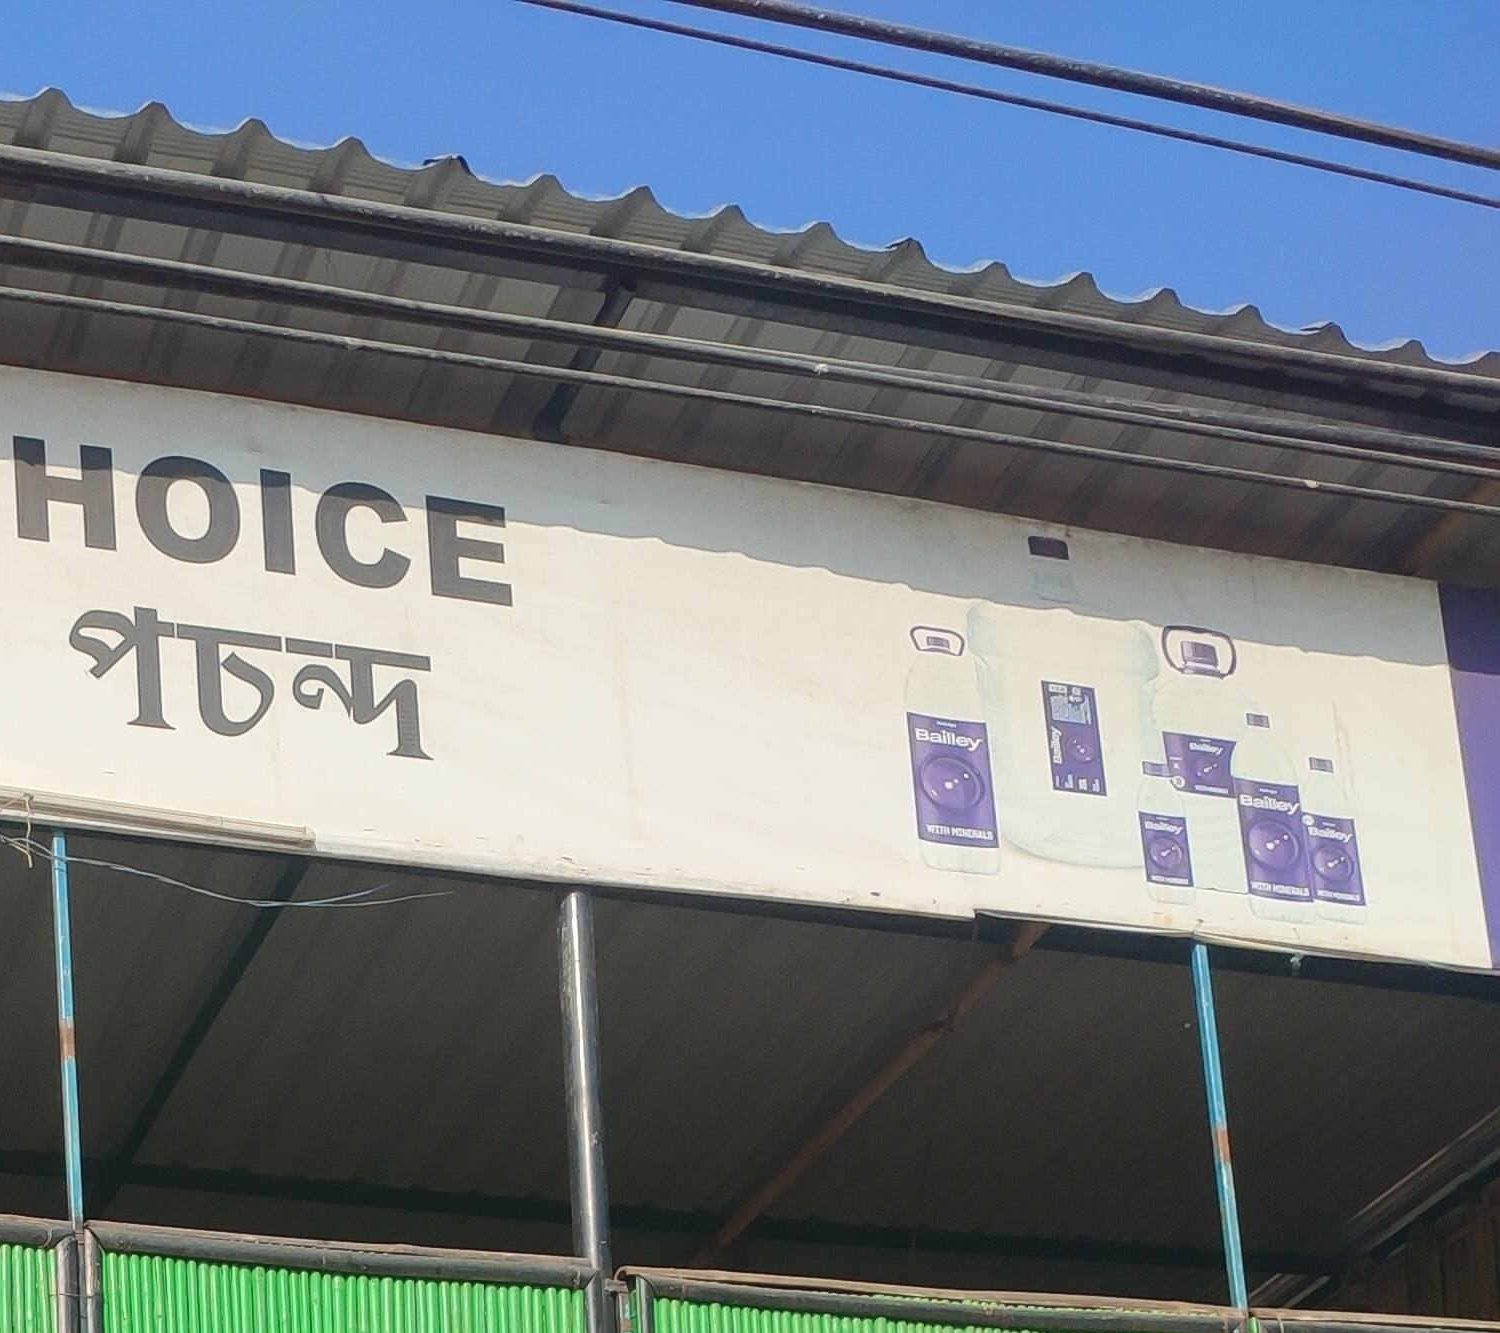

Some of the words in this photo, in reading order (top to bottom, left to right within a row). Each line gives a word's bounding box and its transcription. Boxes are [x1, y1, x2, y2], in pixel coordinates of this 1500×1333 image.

[69, 605, 434, 761] পচন্দ
[914, 727, 984, 752] Bailley
[1240, 793, 1300, 815] Bailley
